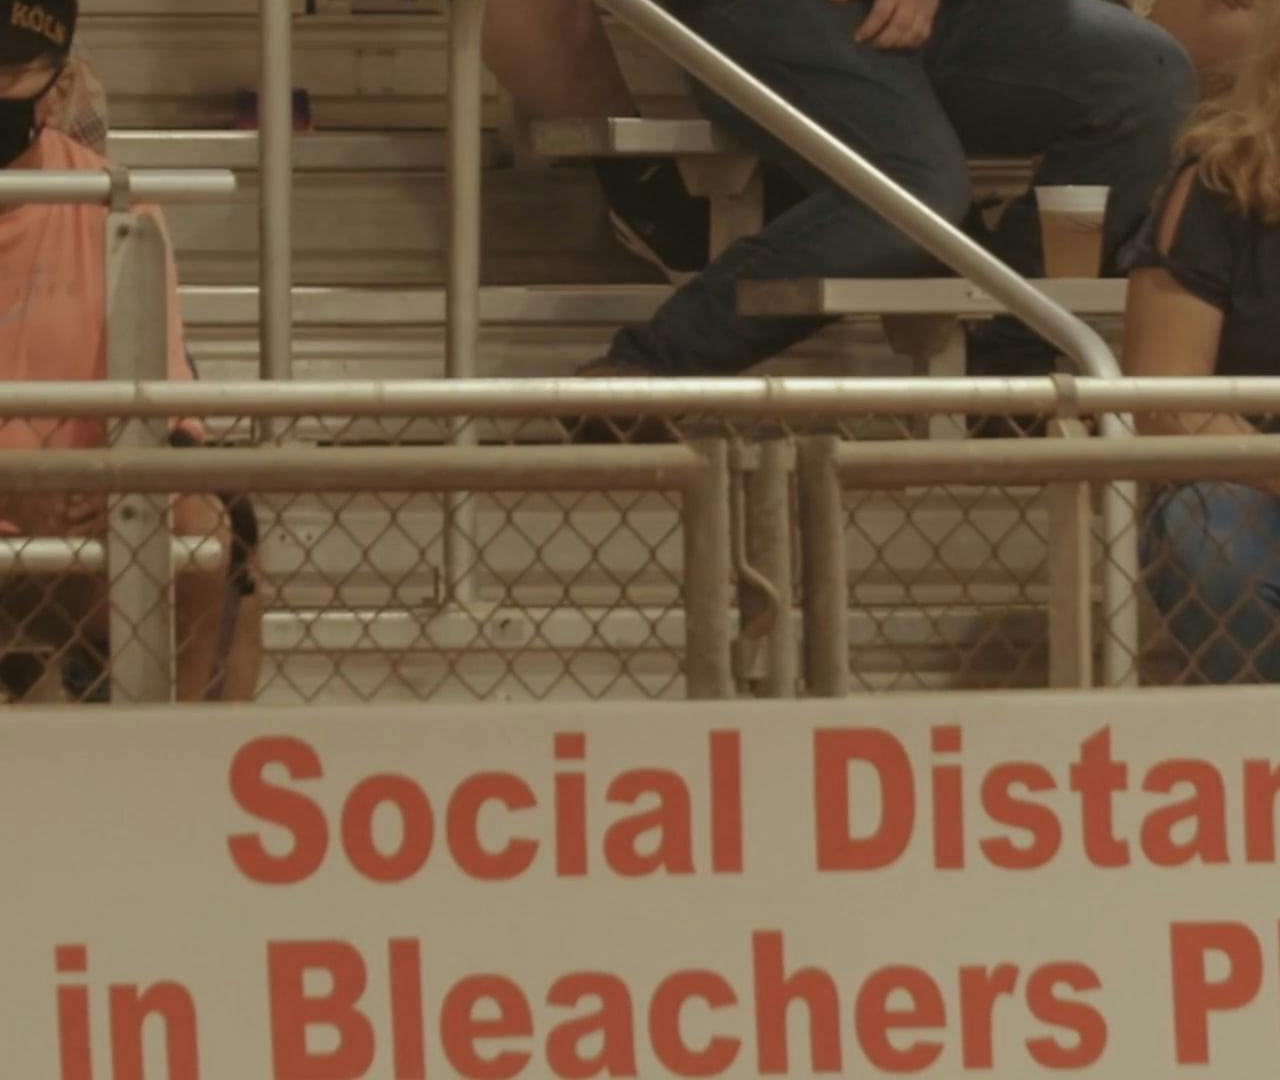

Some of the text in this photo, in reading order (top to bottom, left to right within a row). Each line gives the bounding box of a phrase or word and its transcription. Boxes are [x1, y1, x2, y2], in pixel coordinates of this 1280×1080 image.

[228, 729, 744, 885] Social
[55, 945, 200, 1080] in
[266, 930, 1107, 1080] Bleachers
